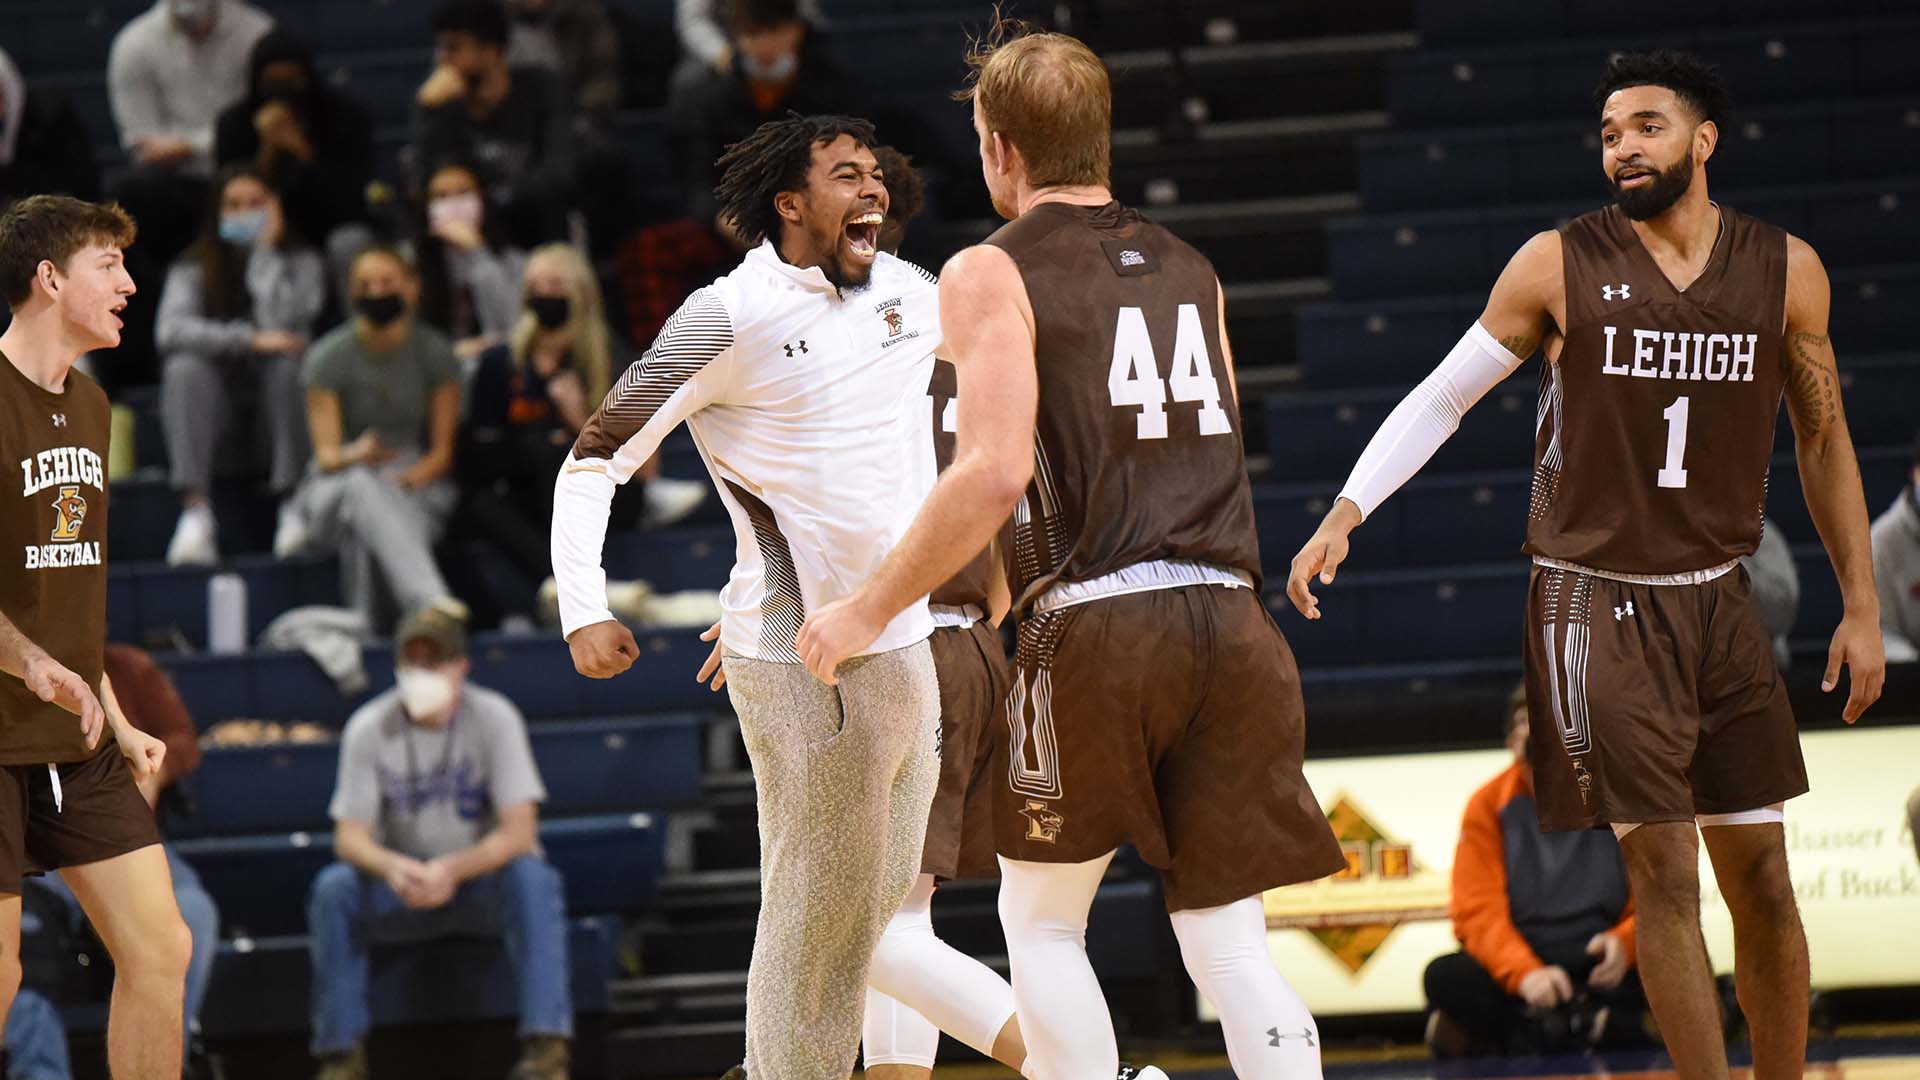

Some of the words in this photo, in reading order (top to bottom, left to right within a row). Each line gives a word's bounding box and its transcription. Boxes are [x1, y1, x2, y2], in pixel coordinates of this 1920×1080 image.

[1107, 303, 1233, 440] 44
[1602, 326, 1758, 382] LEHIGH
[21, 446, 104, 498] LEHIGH
[1657, 396, 1690, 489] 1
